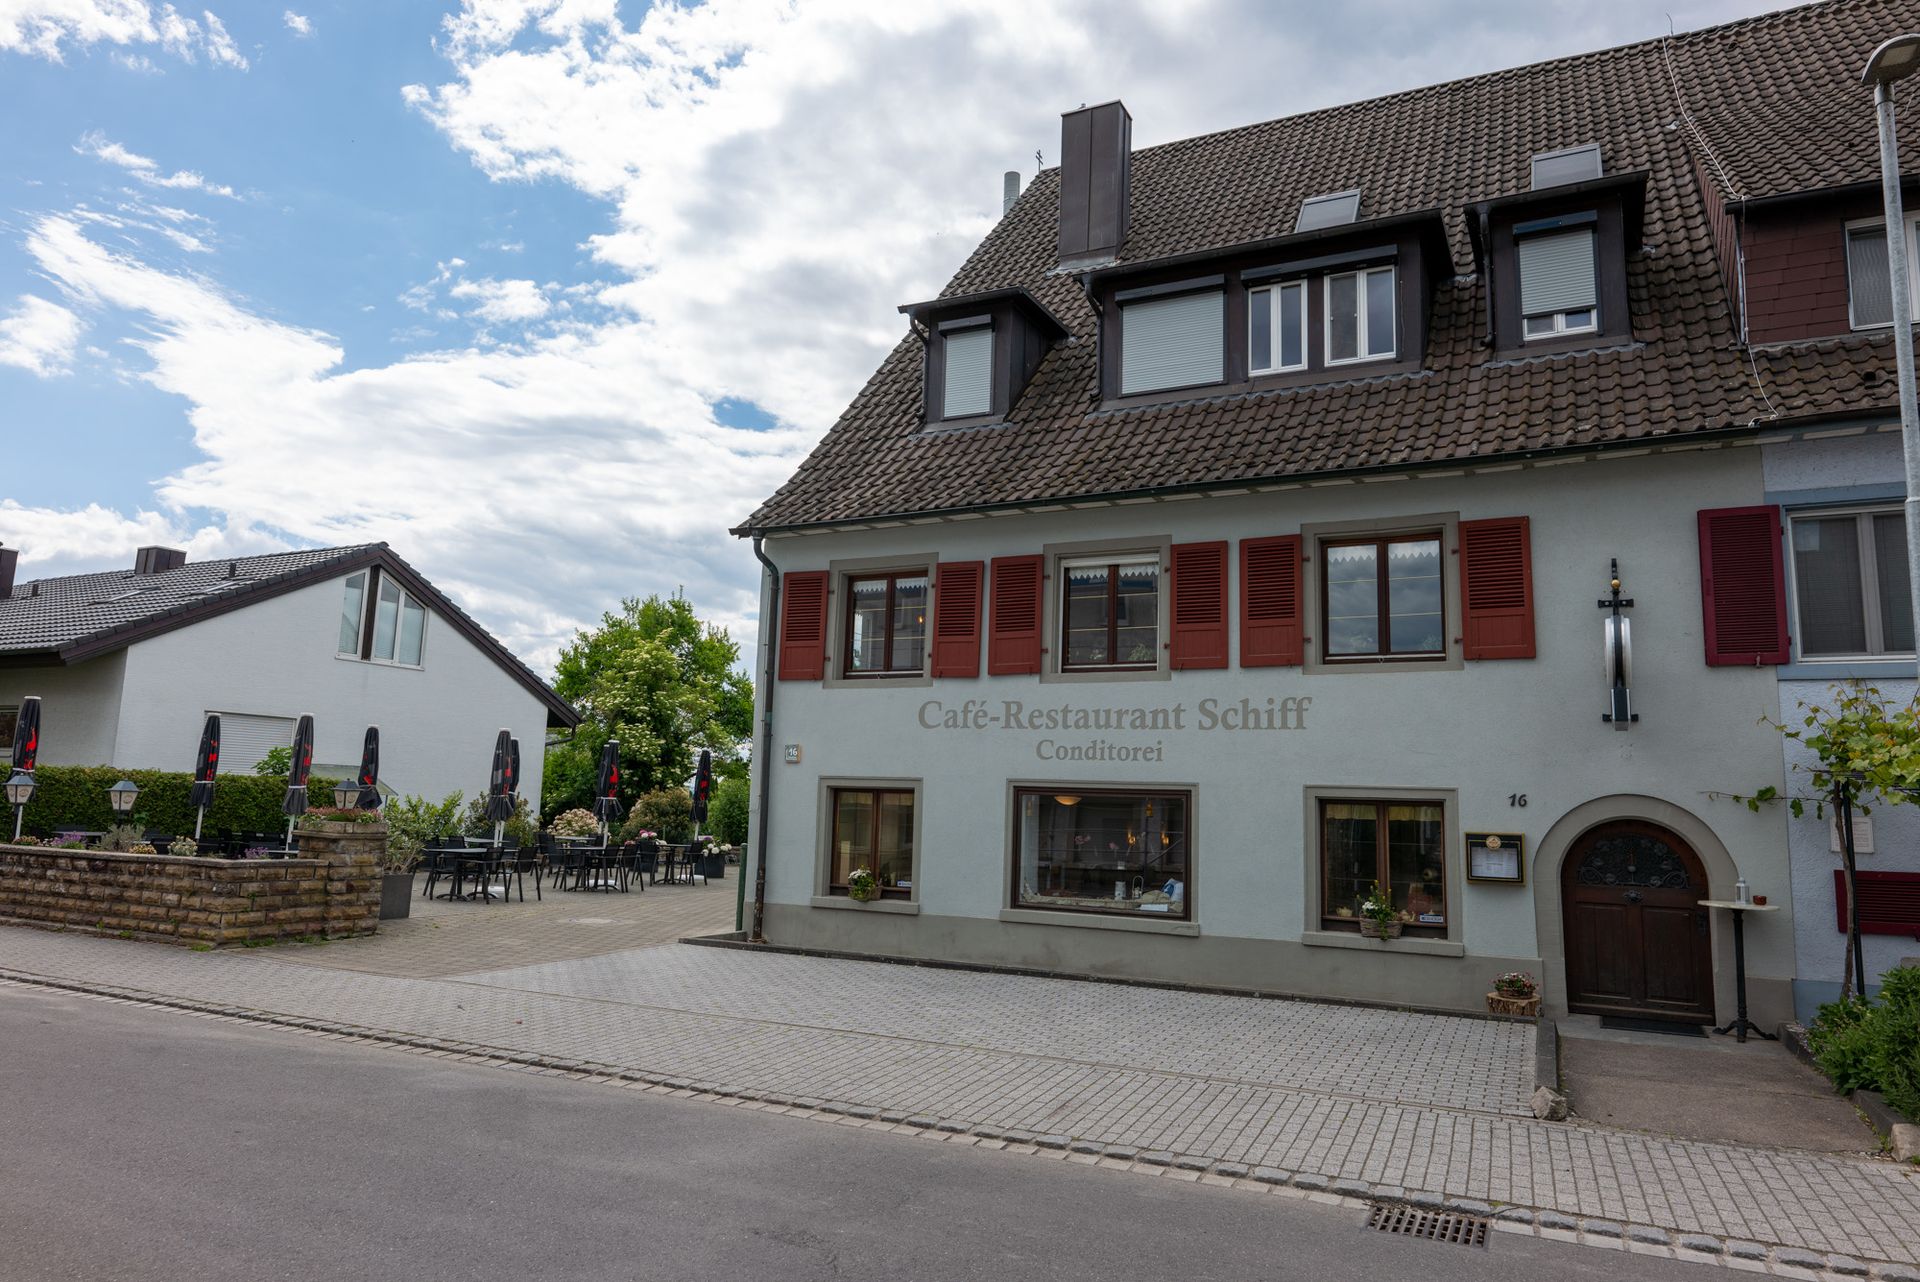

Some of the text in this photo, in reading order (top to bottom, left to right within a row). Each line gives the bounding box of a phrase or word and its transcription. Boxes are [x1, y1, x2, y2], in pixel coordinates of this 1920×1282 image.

[918, 697, 1312, 730] Café-Restaurant Schiff
[1036, 739, 1163, 762] Conditorei
[1508, 793, 1527, 807] 16
